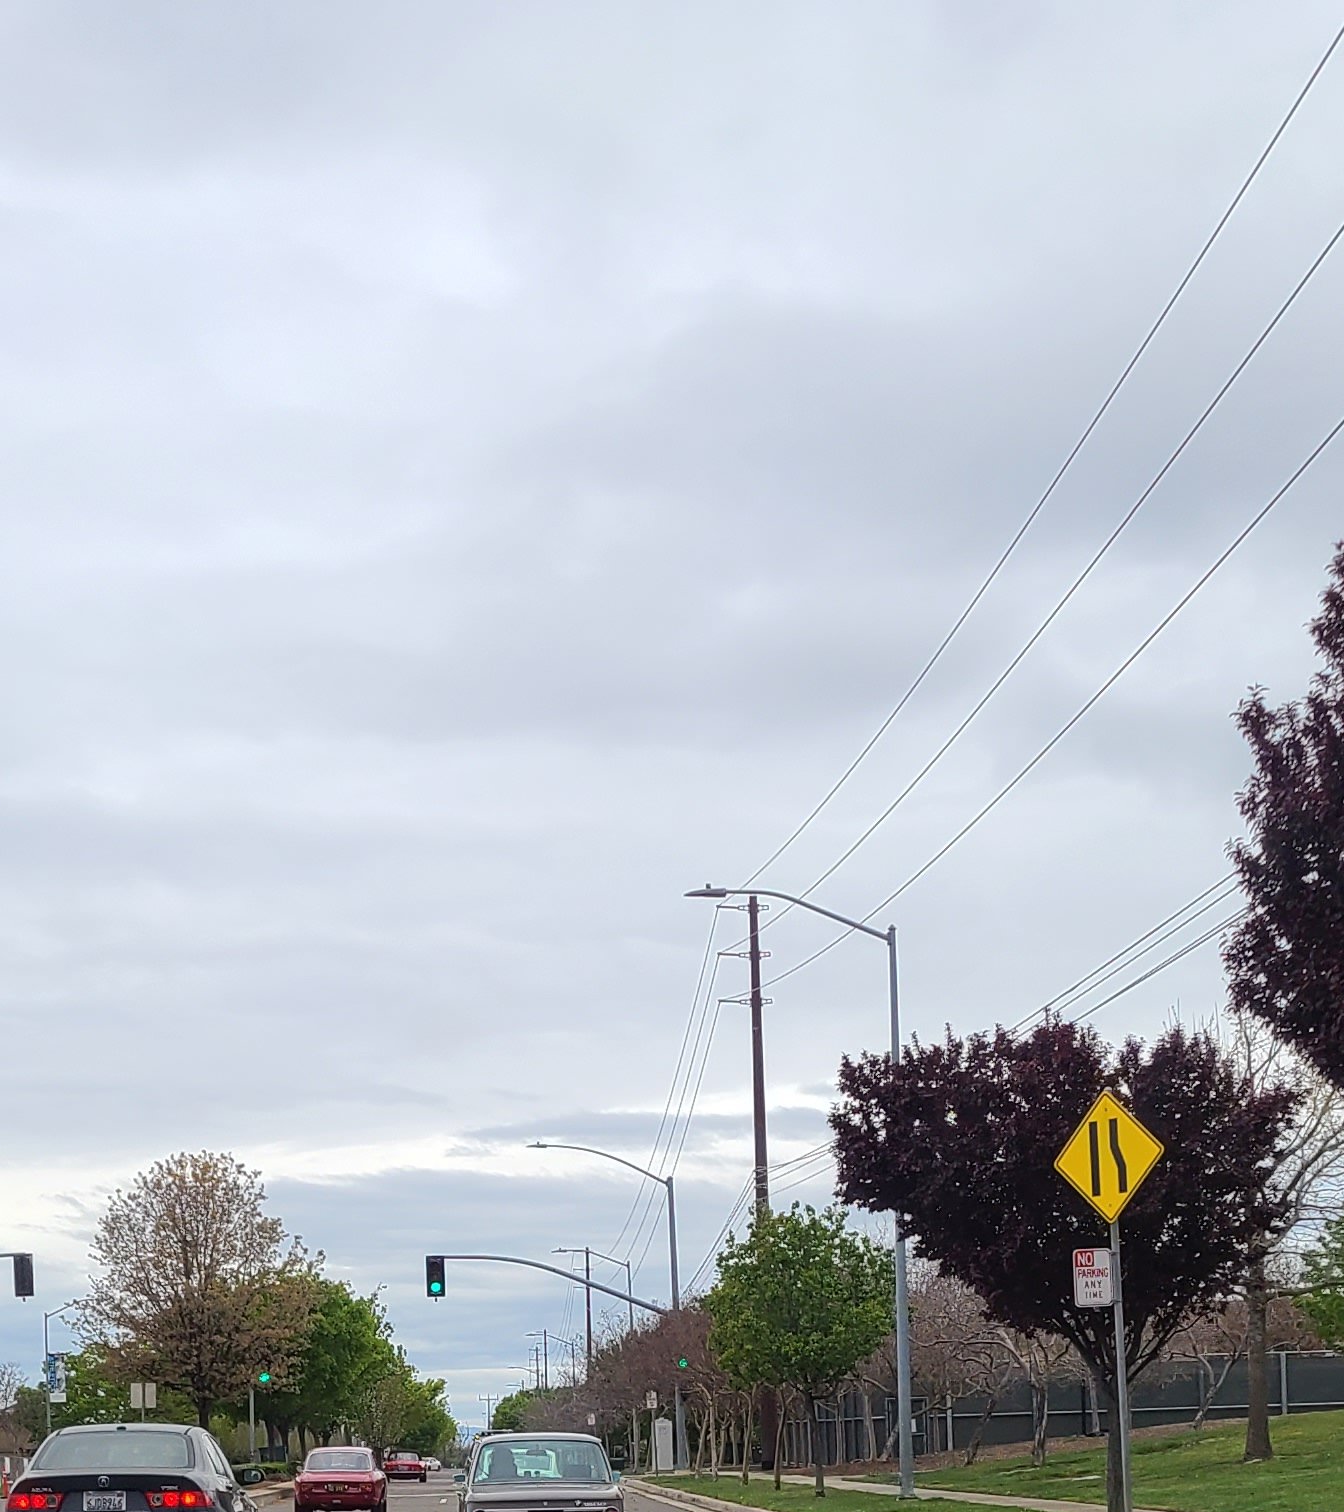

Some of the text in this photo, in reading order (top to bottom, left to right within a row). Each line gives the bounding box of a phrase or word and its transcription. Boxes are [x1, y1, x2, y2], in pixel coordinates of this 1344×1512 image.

[1077, 1252, 1093, 1266] NO
[1077, 1268, 1109, 1278] PARKING
[1084, 1280, 1102, 1288] ANY
[1085, 1291, 1103, 1299] TIME
